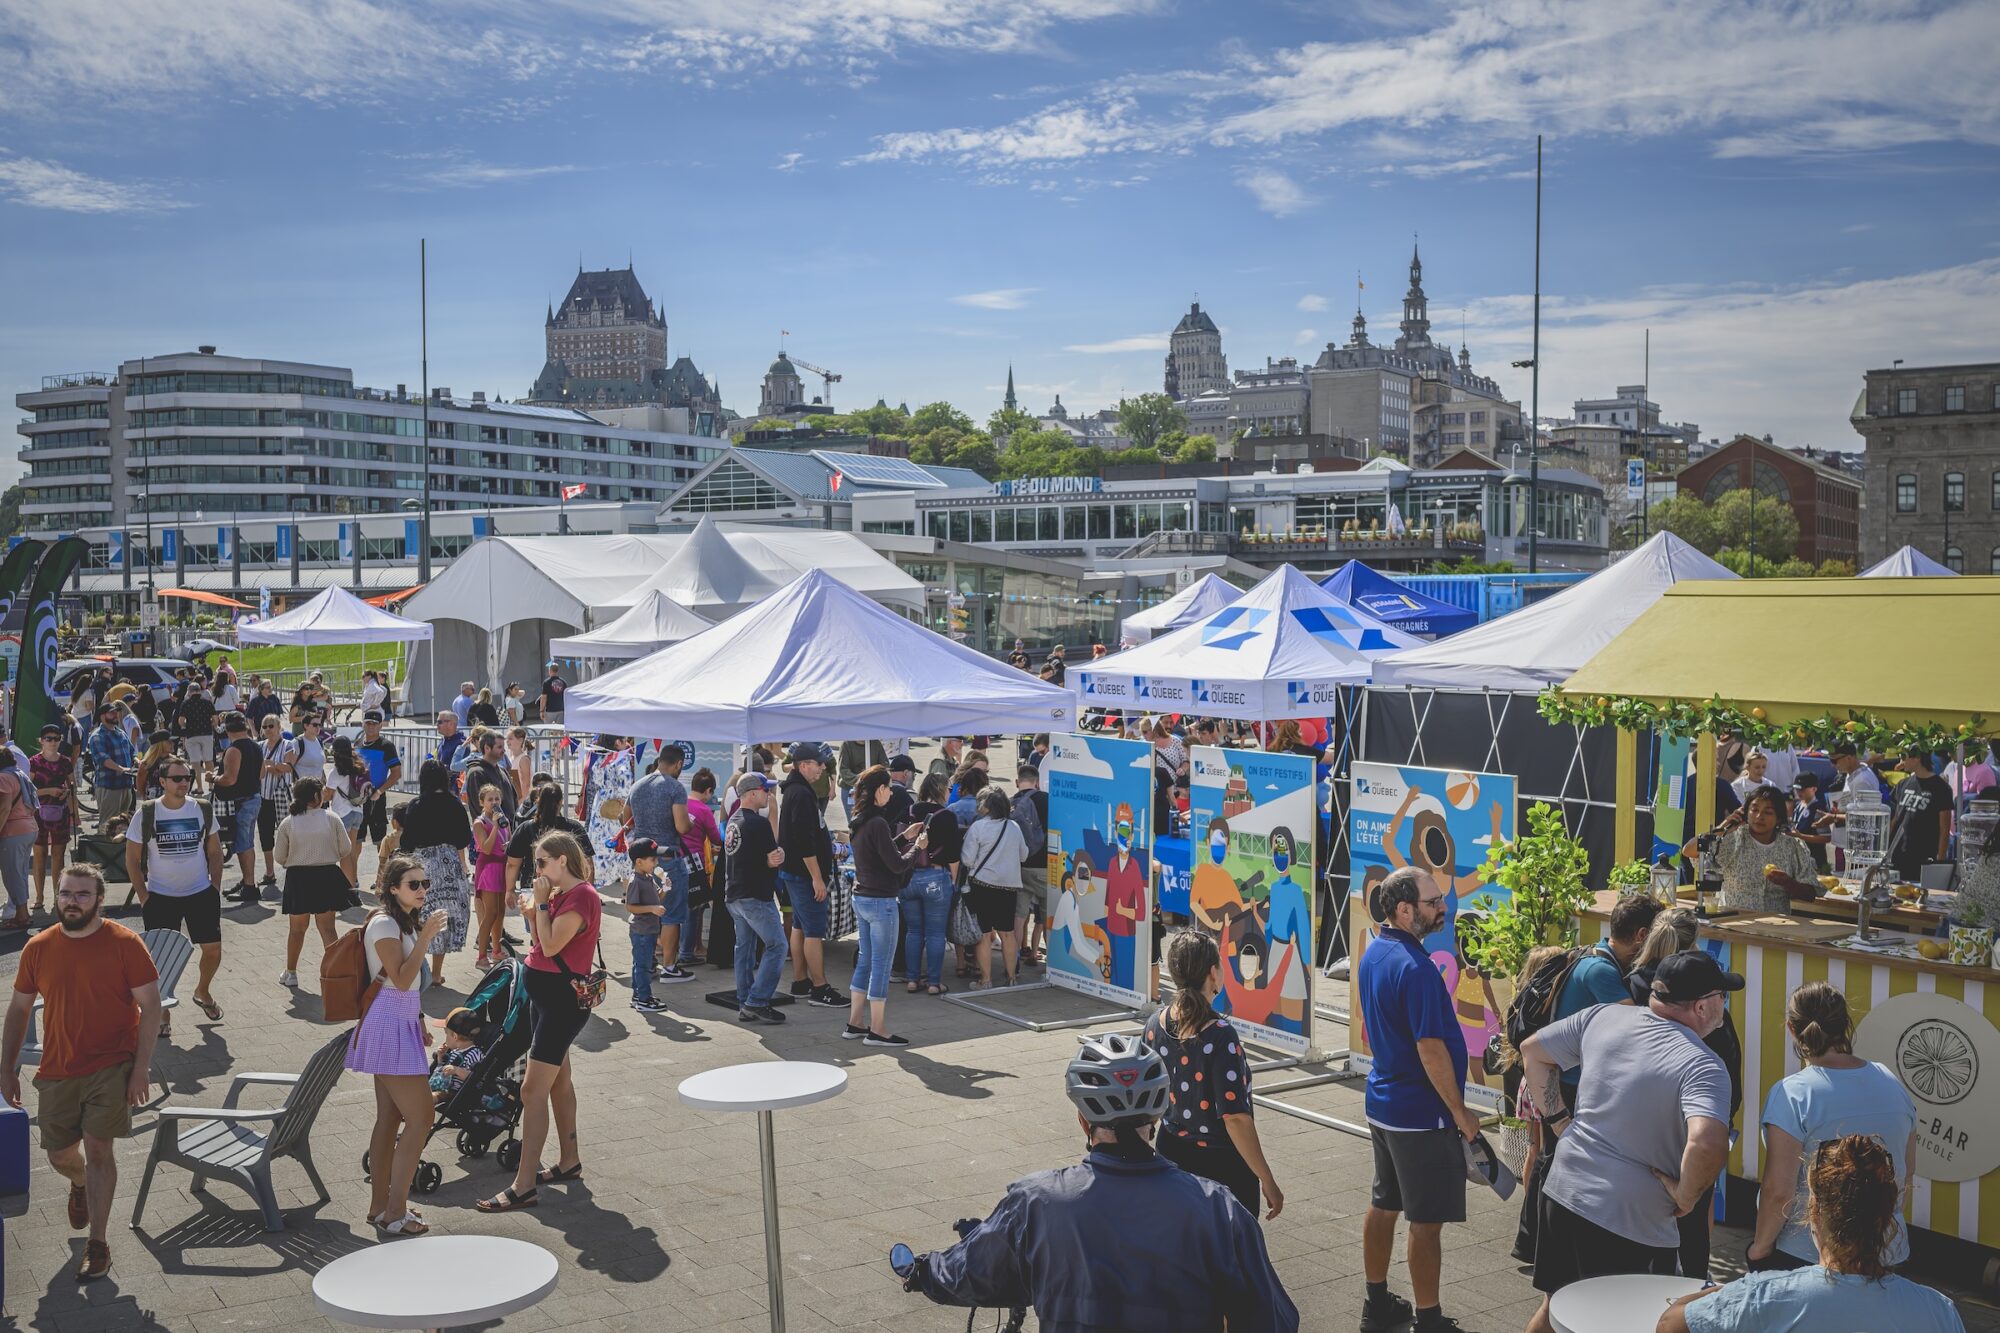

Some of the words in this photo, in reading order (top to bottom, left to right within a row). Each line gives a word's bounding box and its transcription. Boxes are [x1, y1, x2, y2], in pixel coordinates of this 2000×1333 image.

[993, 474, 1028, 496] CAFÉ
[1030, 477, 1049, 493] DU
[1051, 476, 1103, 493] MONDE
[1313, 691, 1334, 704] QUE
[1248, 766, 1257, 775] ON
[1260, 767, 1273, 777] EST
[1275, 769, 1303, 780] FESTIFS
[1052, 778, 1060, 787] ON
[1899, 793, 1930, 810] JETS
[1356, 820, 1368, 830] ON
[1370, 821, 1392, 833] AIME
[1356, 830, 1379, 845] L'ÉTÉ
